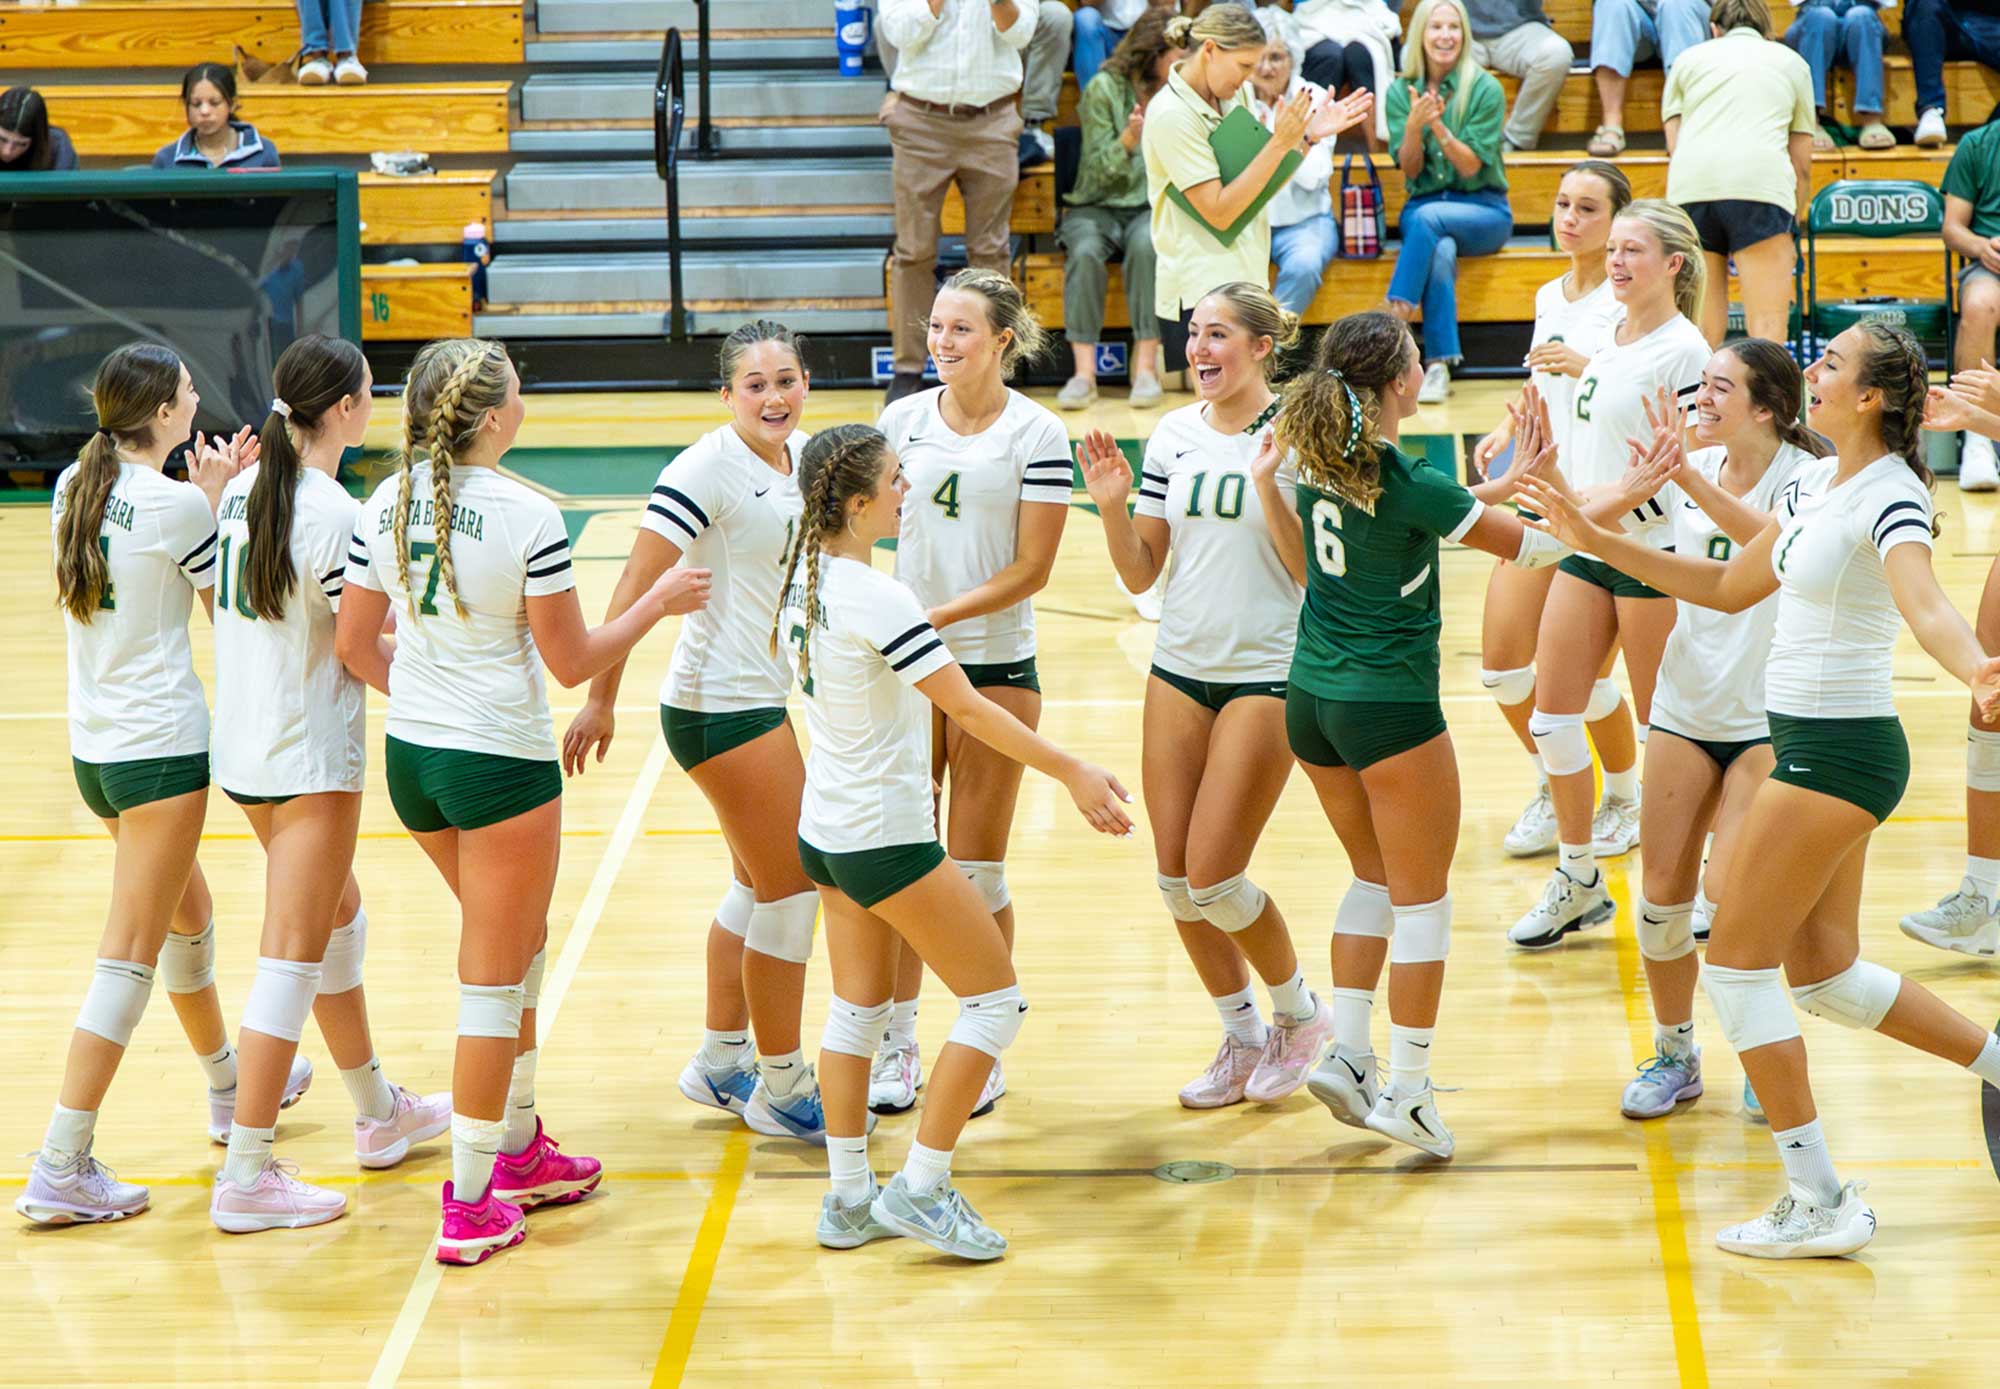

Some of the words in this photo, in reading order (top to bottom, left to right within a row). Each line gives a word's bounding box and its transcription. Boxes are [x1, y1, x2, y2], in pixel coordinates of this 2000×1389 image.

[1831, 193, 1928, 225] DONS
[371, 292, 391, 322] 16
[1577, 376, 1599, 422] 2
[932, 471, 960, 520] 4
[1185, 471, 1247, 520] 10
[378, 500, 421, 536] SATA
[423, 500, 483, 541] BBARA
[1312, 498, 1348, 577] 6
[410, 540, 440, 617] 7
